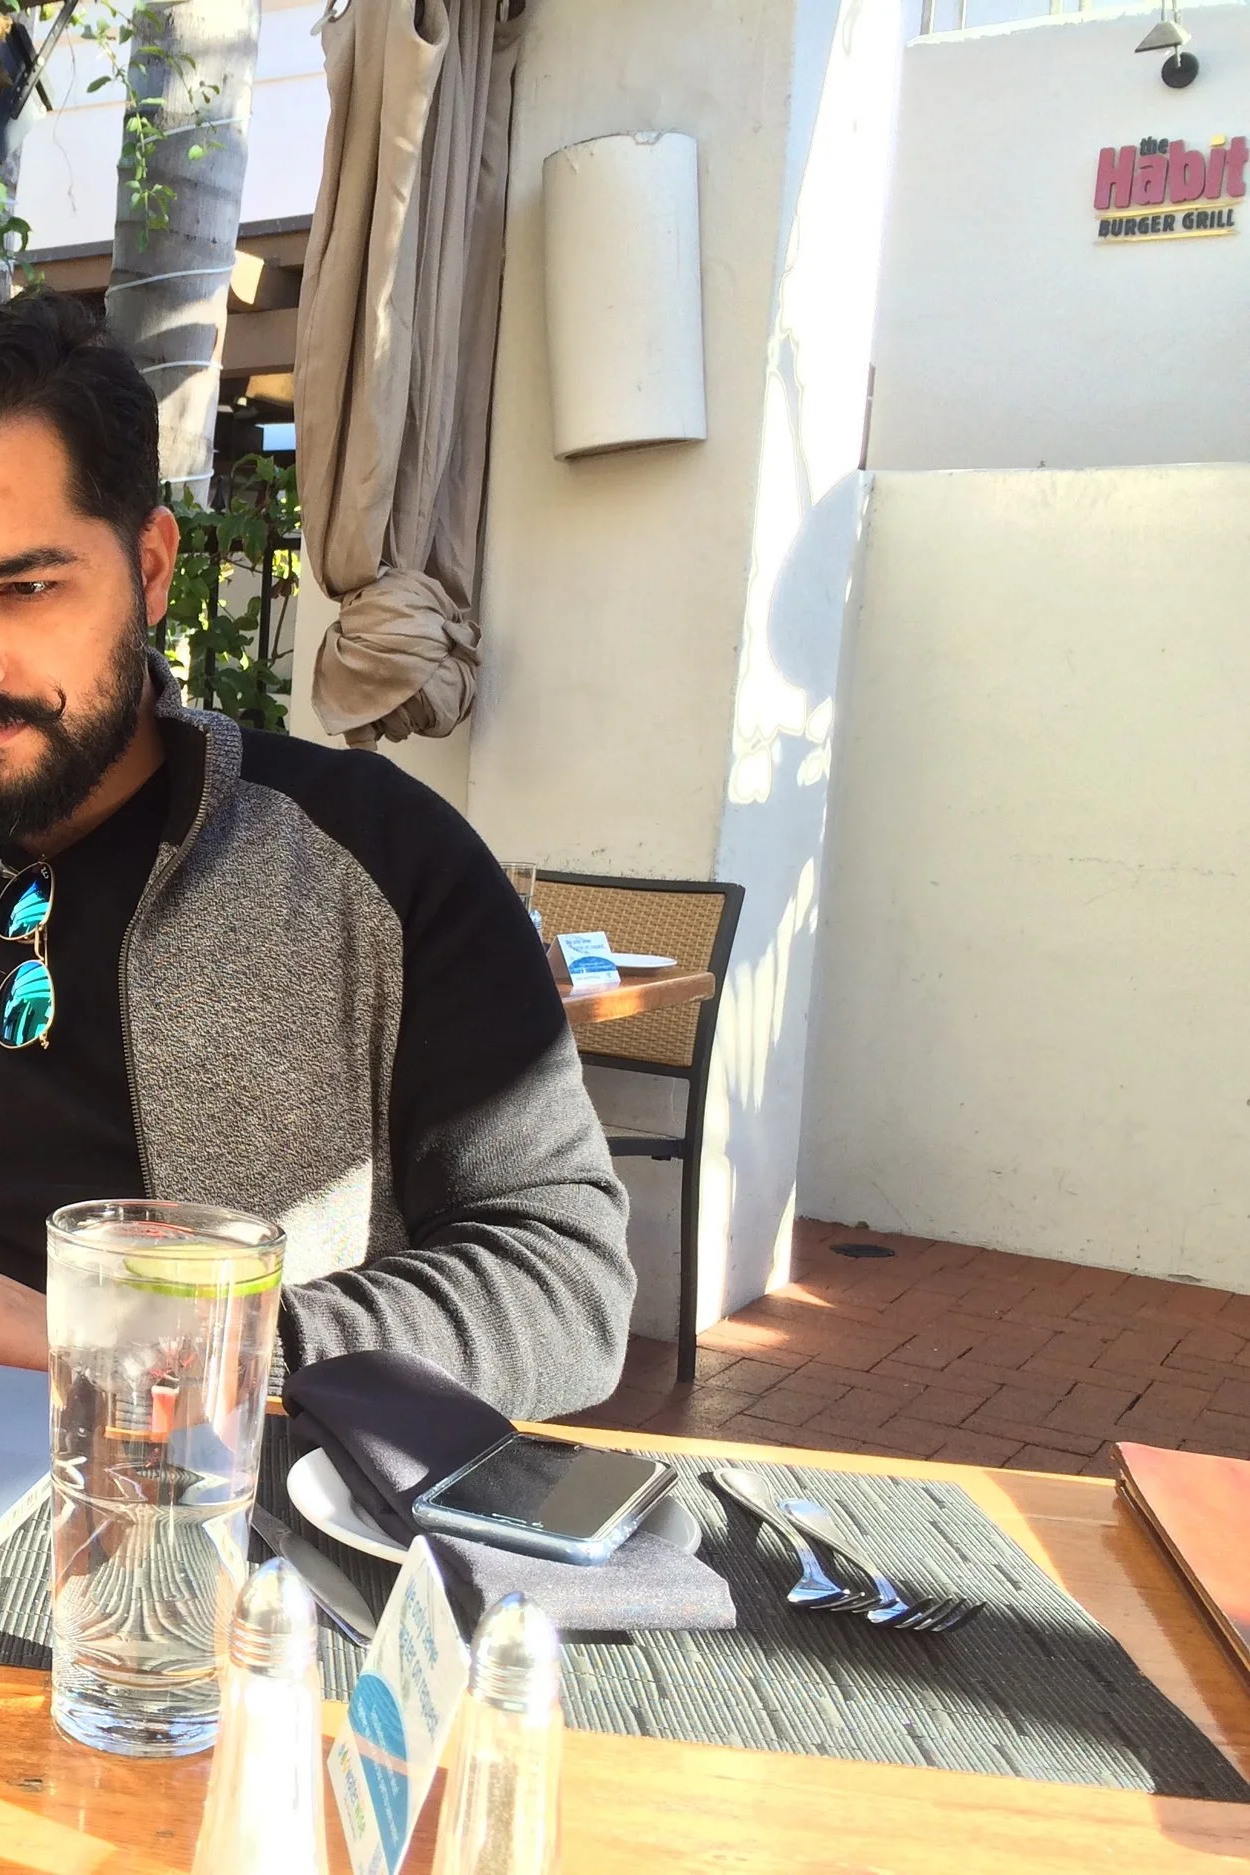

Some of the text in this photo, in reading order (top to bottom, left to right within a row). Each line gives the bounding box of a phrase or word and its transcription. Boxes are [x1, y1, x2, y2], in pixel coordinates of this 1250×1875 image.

[1140, 136, 1168, 156] the
[1094, 133, 1249, 210] Habit
[1098, 209, 1235, 237] BURGER GRILL
